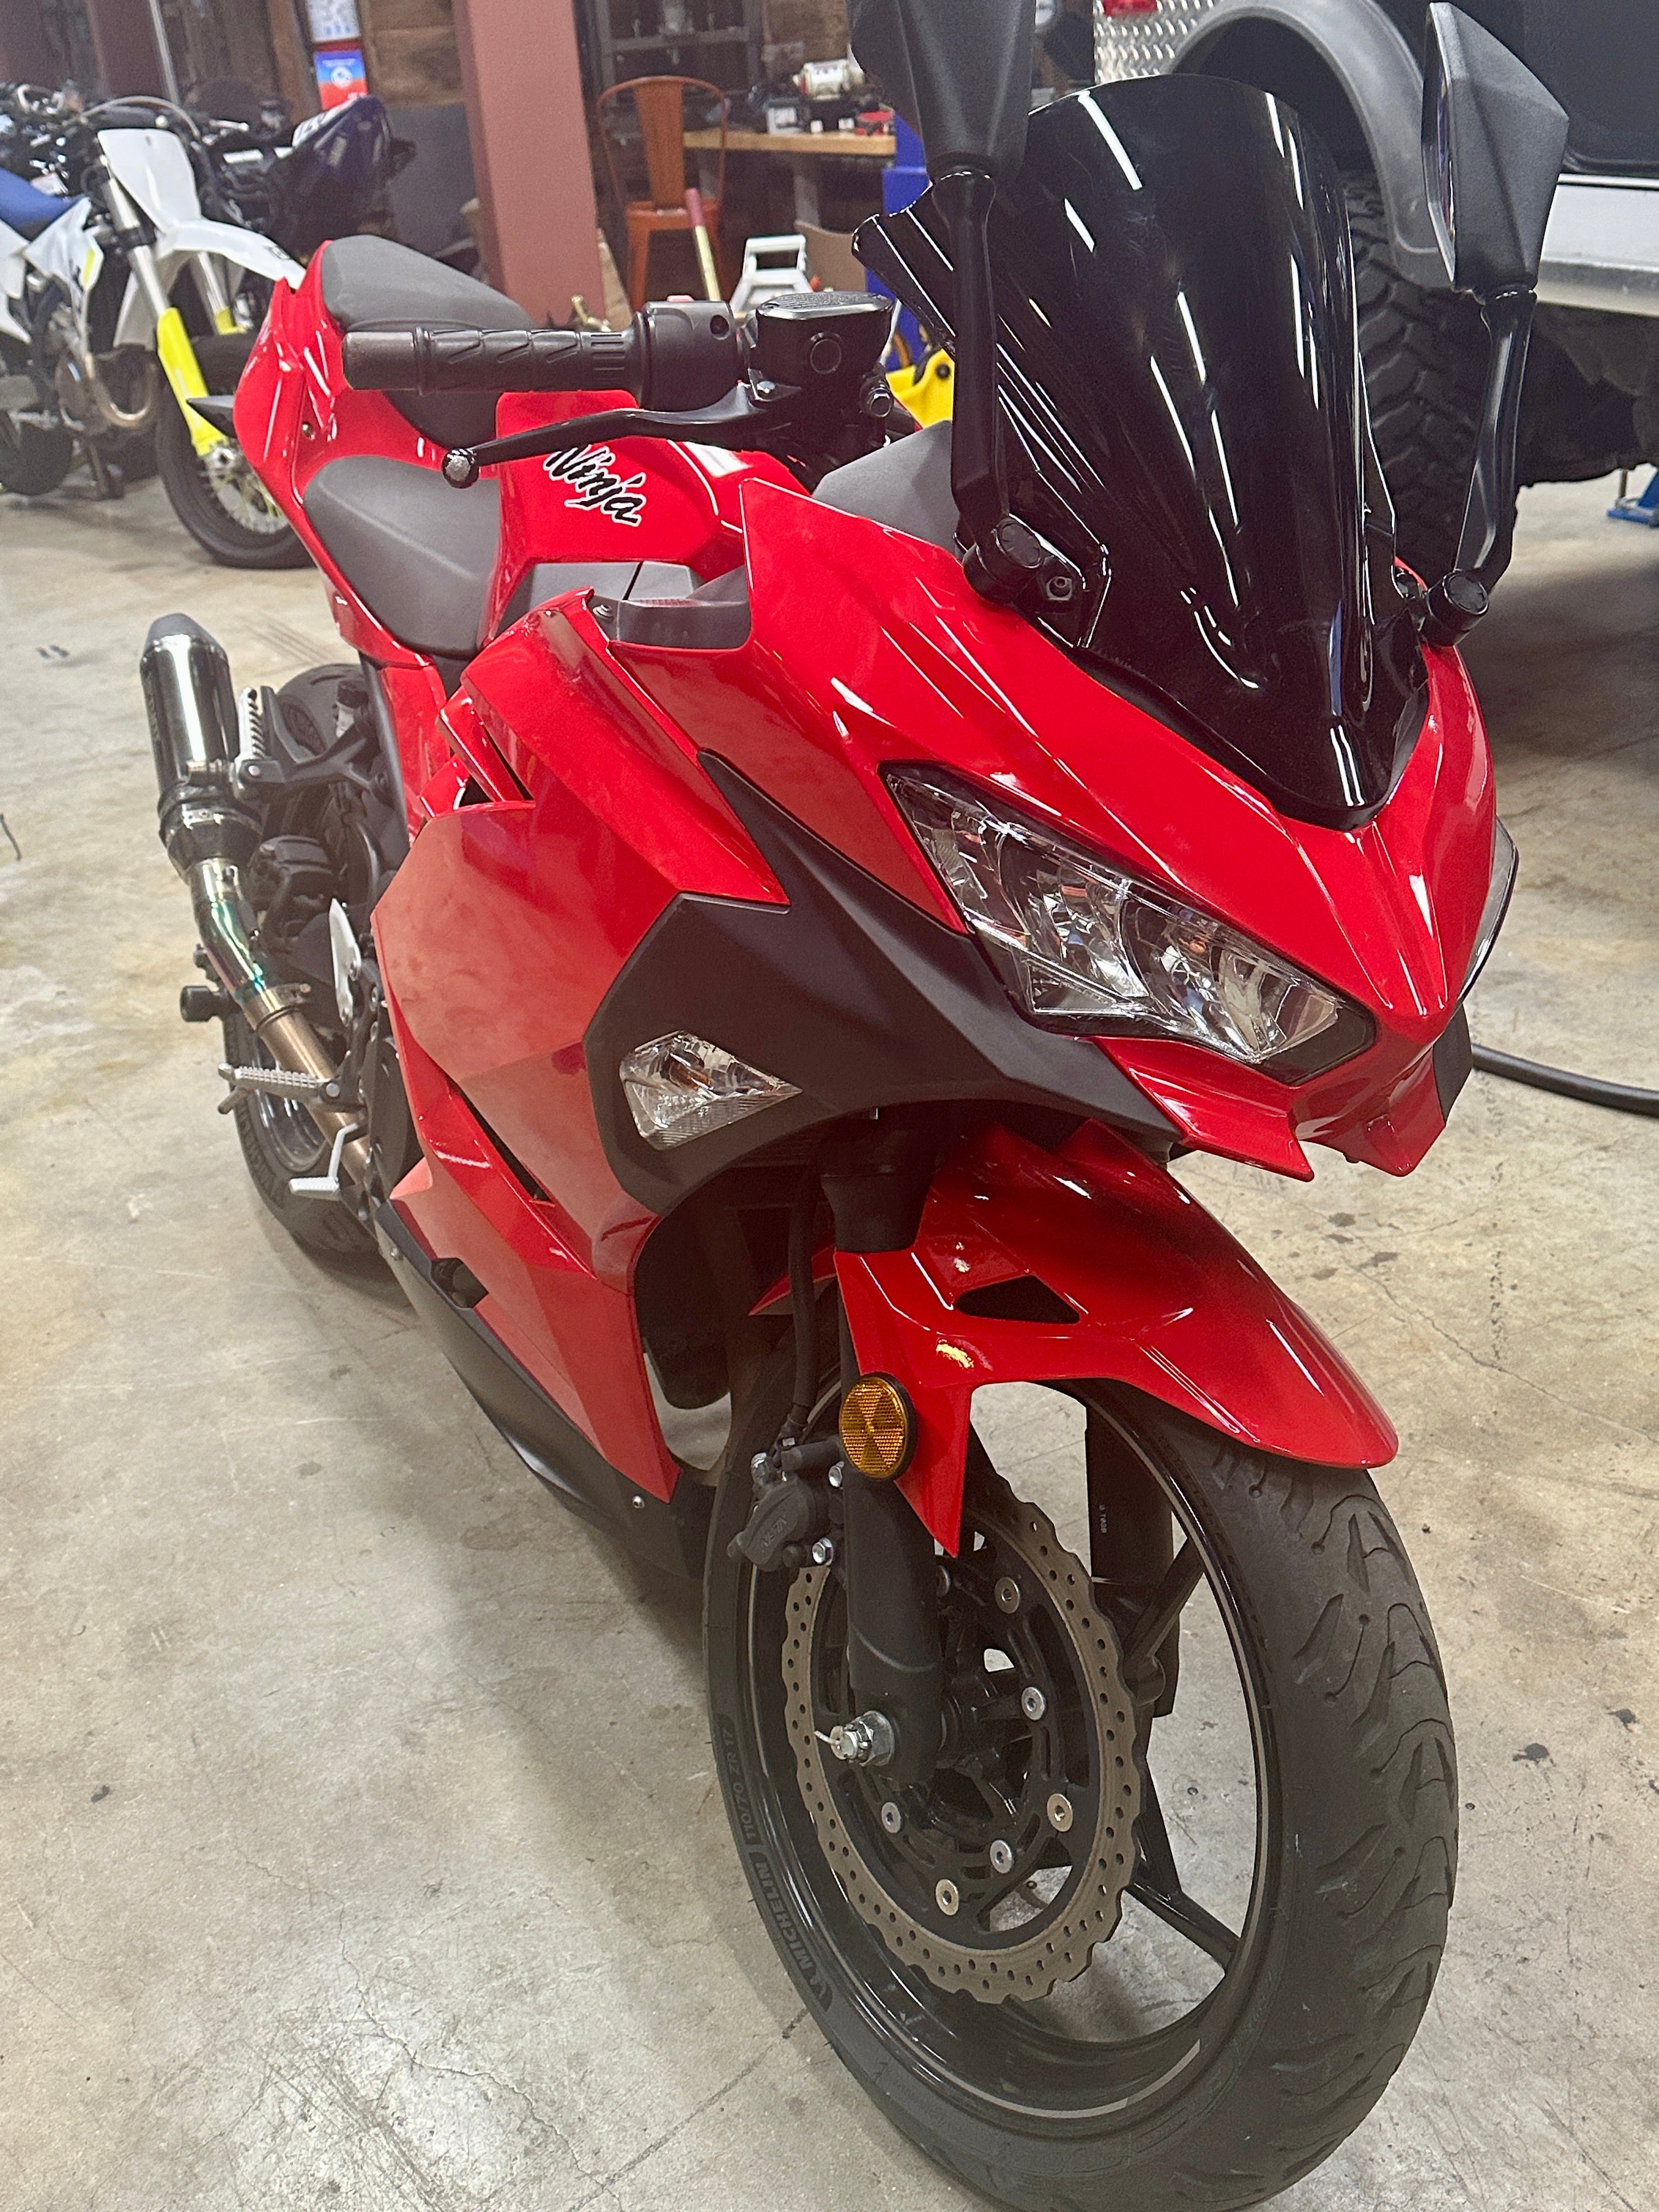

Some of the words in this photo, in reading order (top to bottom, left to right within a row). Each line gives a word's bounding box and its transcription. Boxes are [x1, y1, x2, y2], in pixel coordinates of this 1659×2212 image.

[543, 444, 646, 527] Ninja
[723, 1728, 735, 1746] 17
[733, 1781, 756, 1839] 110/70
[755, 1861, 814, 1970] MICHELIN
